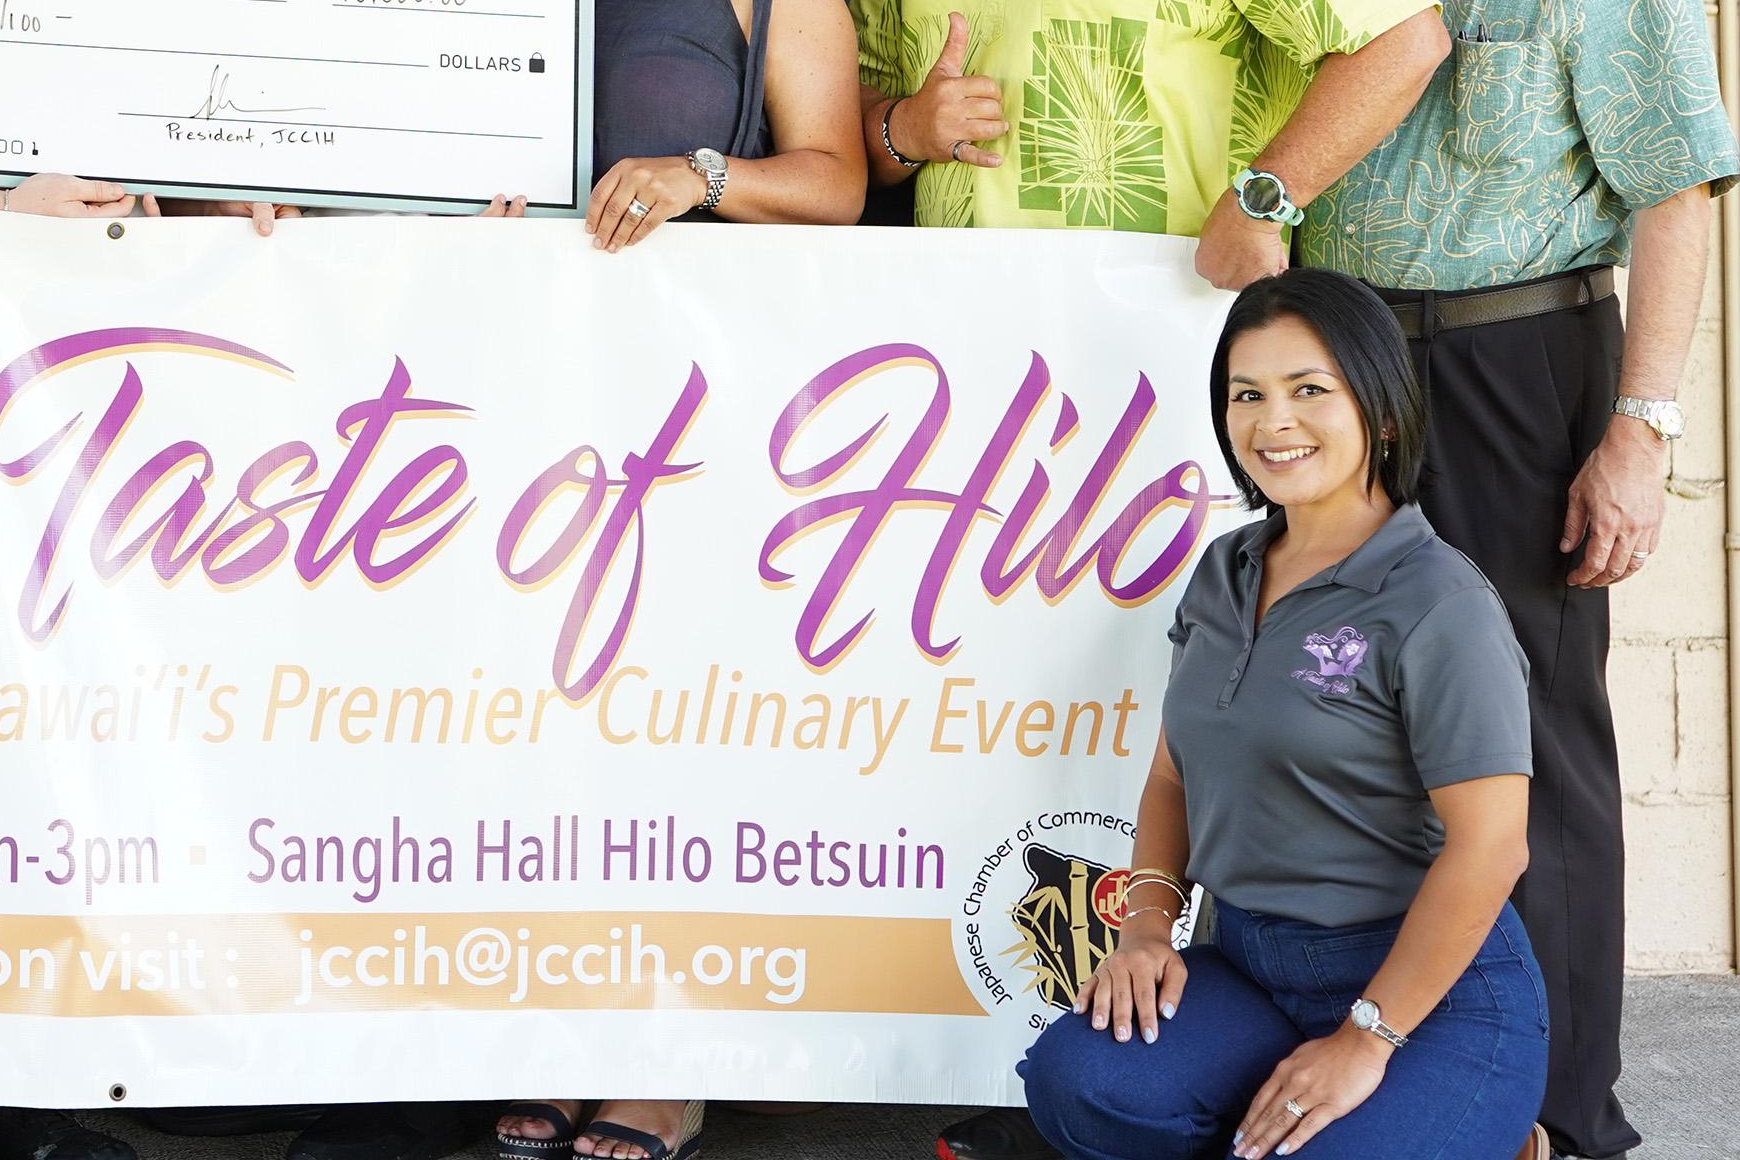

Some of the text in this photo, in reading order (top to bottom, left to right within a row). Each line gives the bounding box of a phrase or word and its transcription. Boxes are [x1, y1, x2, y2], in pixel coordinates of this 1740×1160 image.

[439, 53, 522, 73] DOLLARS
[496, 359, 705, 710] of
[757, 342, 1244, 677] Hilo
[262, 663, 558, 746] Premier
[597, 665, 910, 776] Culinary
[930, 677, 1140, 758] Event
[246, 816, 453, 903] Sangha
[476, 814, 579, 883] Hall
[603, 816, 712, 883] Hilo
[735, 821, 946, 889] Betsuin
[1017, 821, 1034, 842] of
[963, 838, 1014, 916] Chamber
[80, 928, 205, 991] visit
[294, 924, 808, 1005] jccih@jccih.org
[966, 923, 1013, 1005] Japanese
